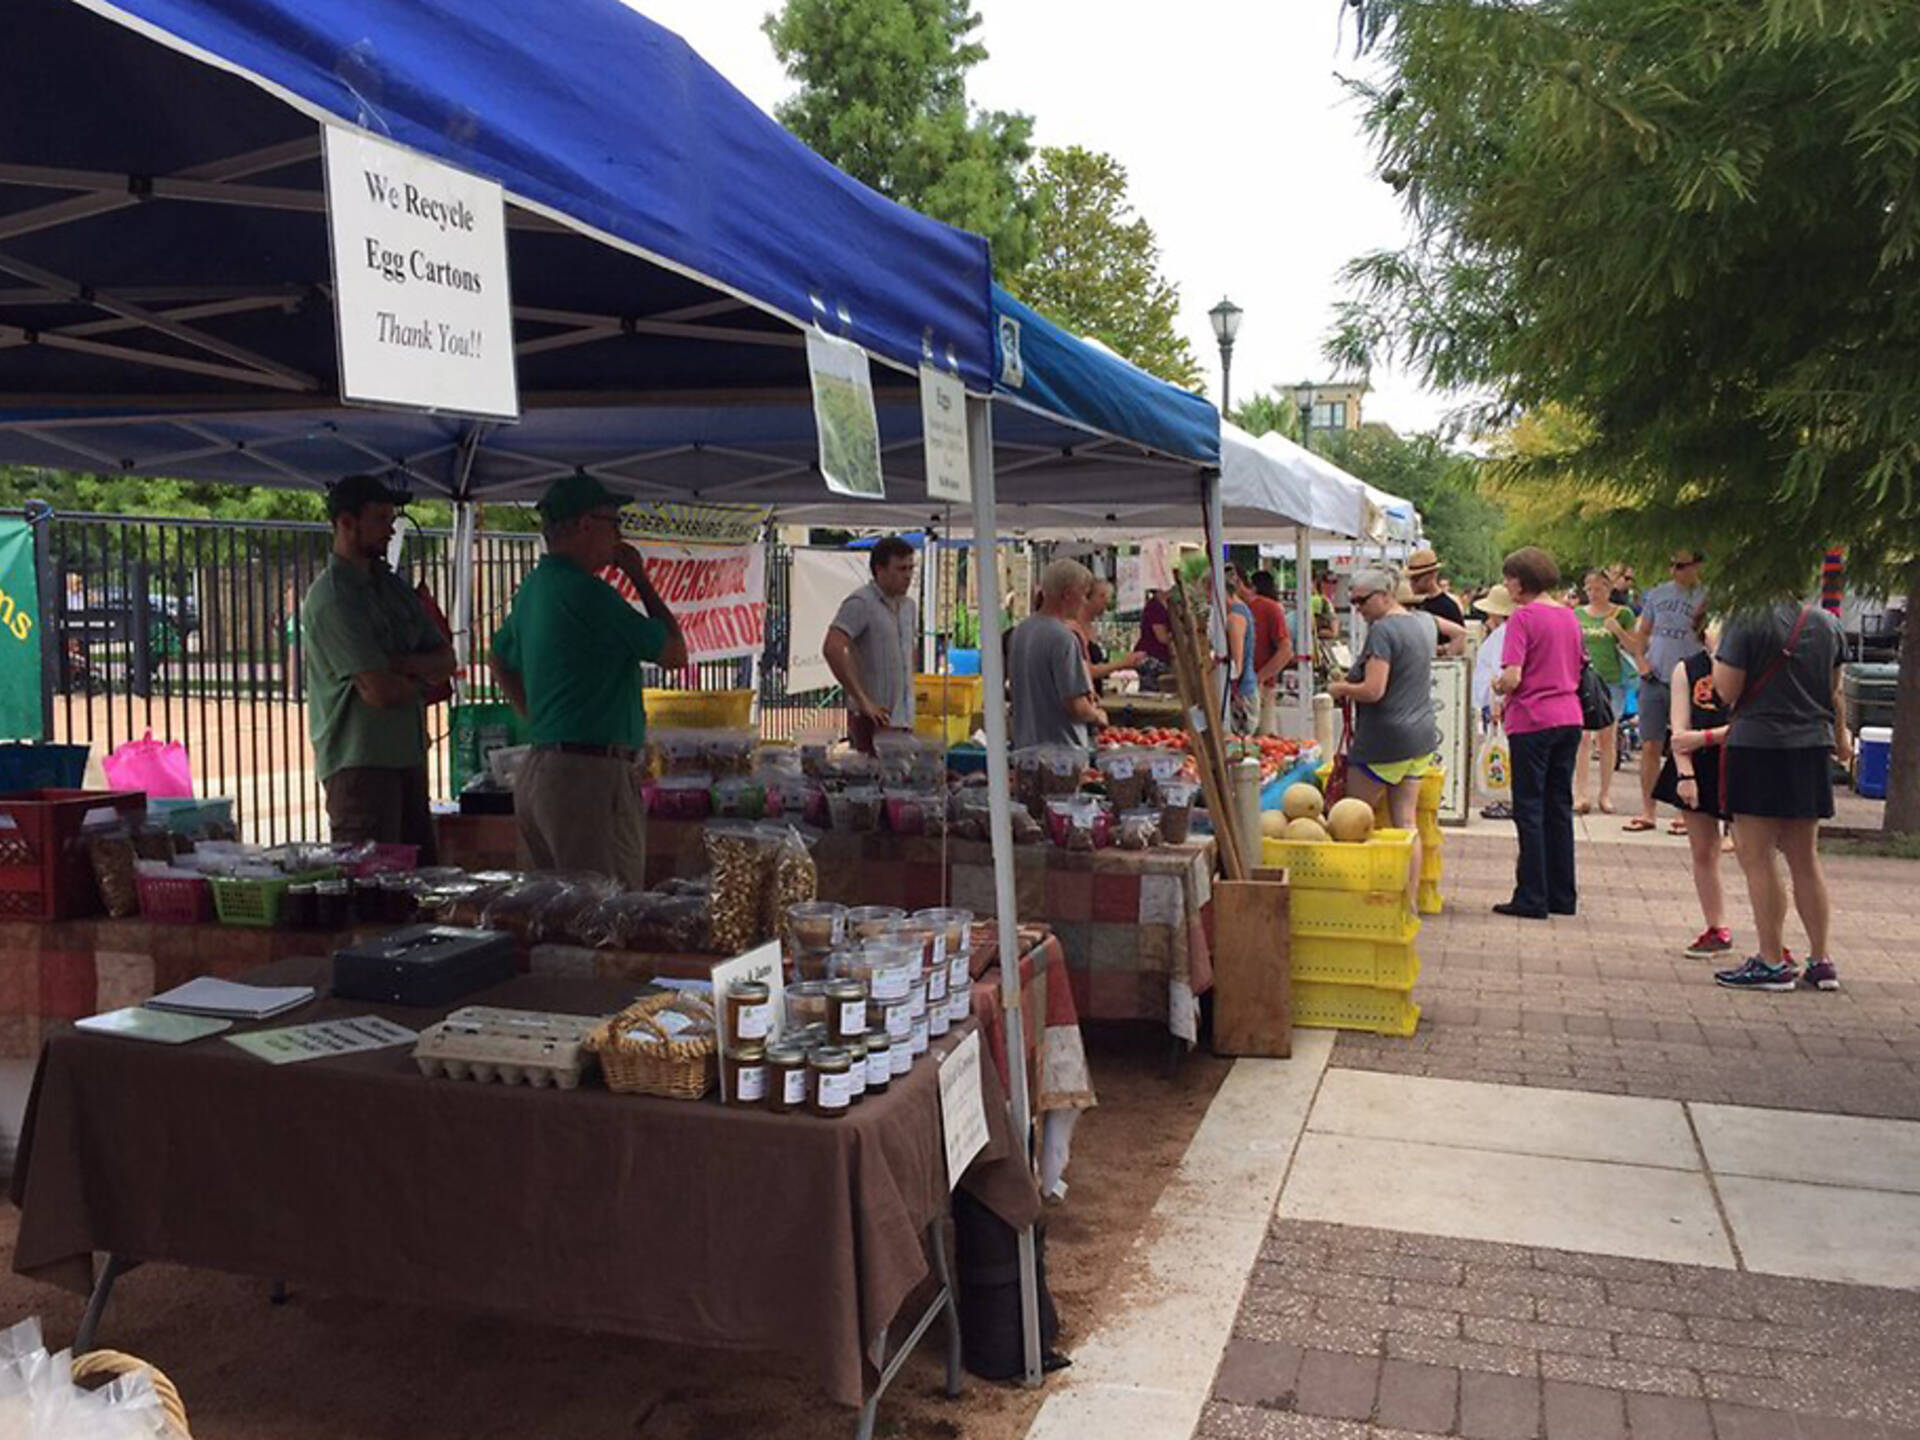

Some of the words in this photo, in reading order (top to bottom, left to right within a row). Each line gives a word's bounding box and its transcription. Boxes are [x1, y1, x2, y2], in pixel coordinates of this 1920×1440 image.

[364, 171, 398, 210] We
[404, 182, 475, 232] Recycle
[364, 237, 407, 283] Egg
[409, 249, 482, 294] Cartons
[376, 311, 433, 351] Thank
[438, 322, 482, 359] You!!
